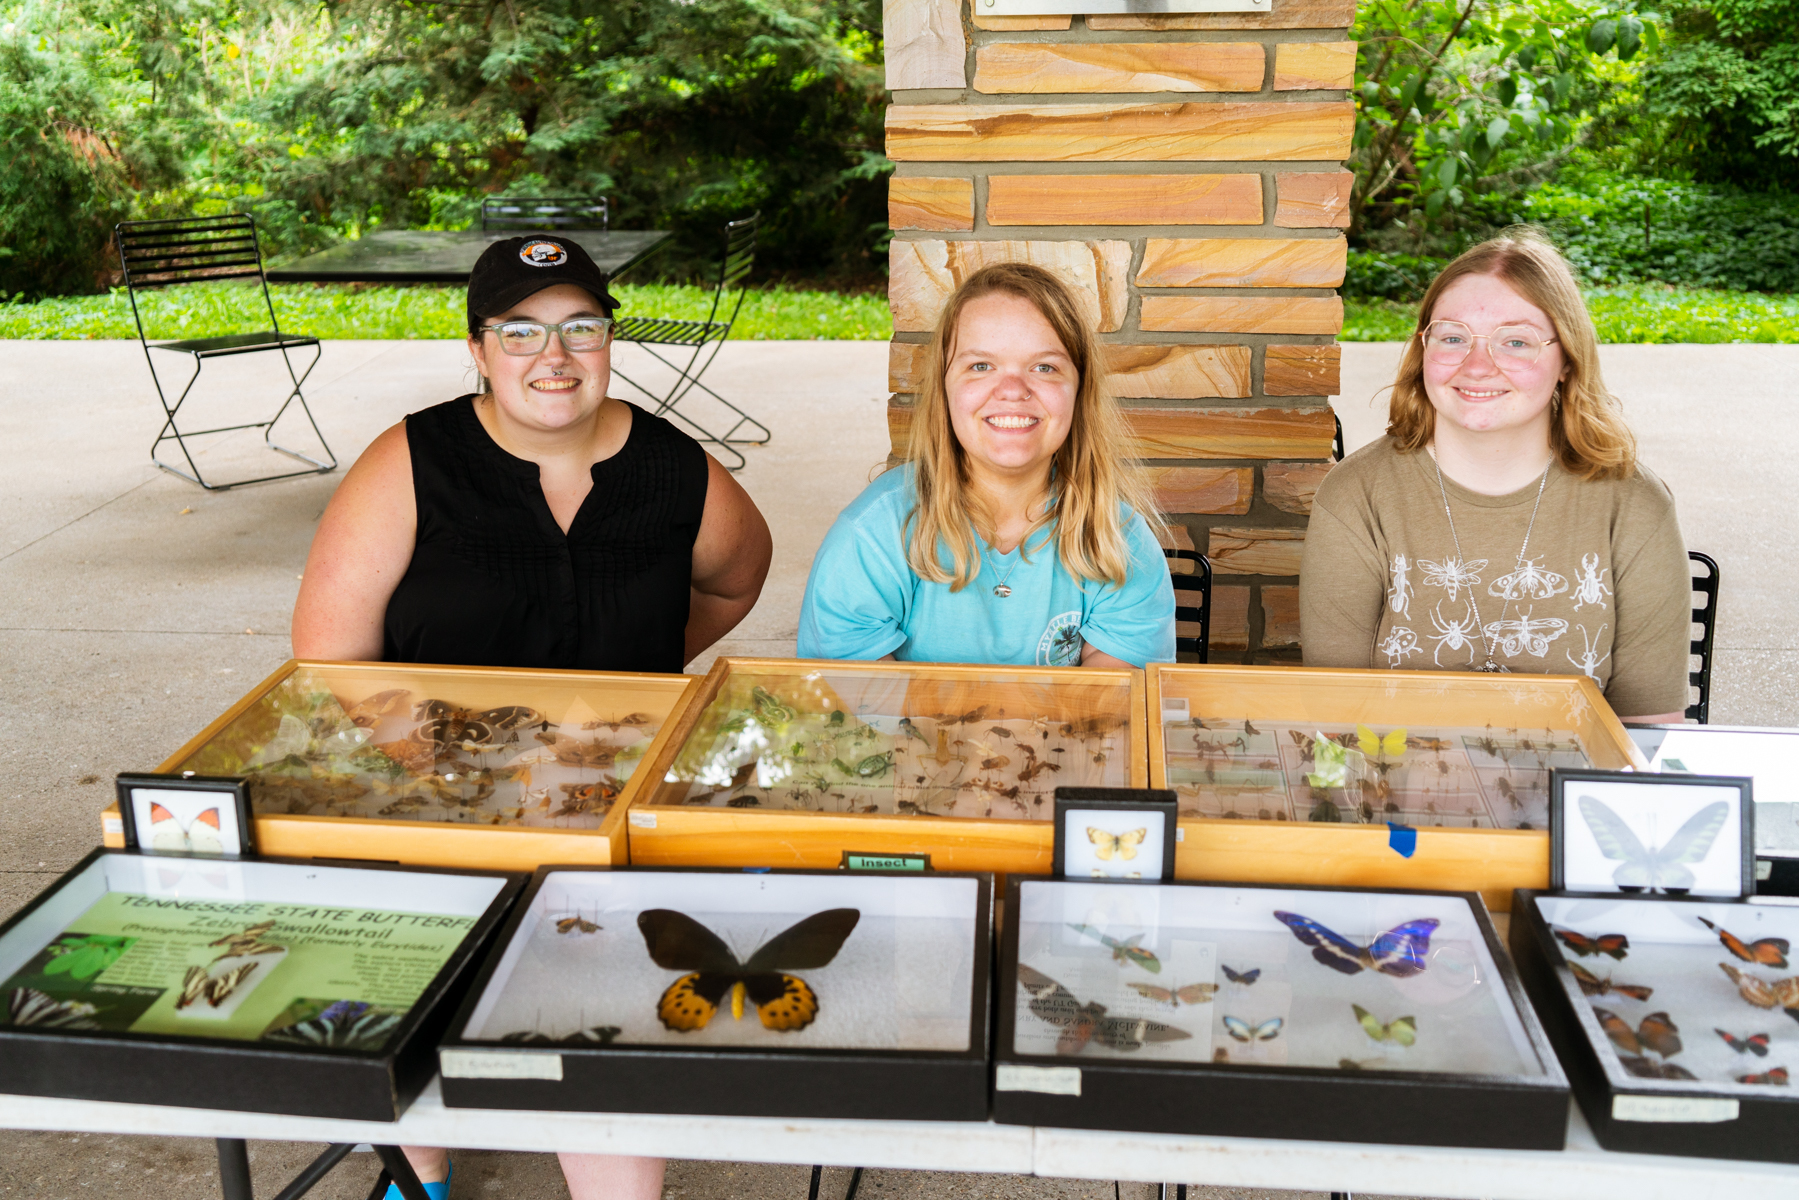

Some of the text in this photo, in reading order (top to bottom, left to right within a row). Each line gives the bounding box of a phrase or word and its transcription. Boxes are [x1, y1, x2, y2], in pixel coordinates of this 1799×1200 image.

[861, 858, 908, 868] Insect
[121, 895, 265, 916] TENNESSEE
[267, 906, 354, 922] STATE
[188, 916, 394, 939] Zebra Swallowtail
